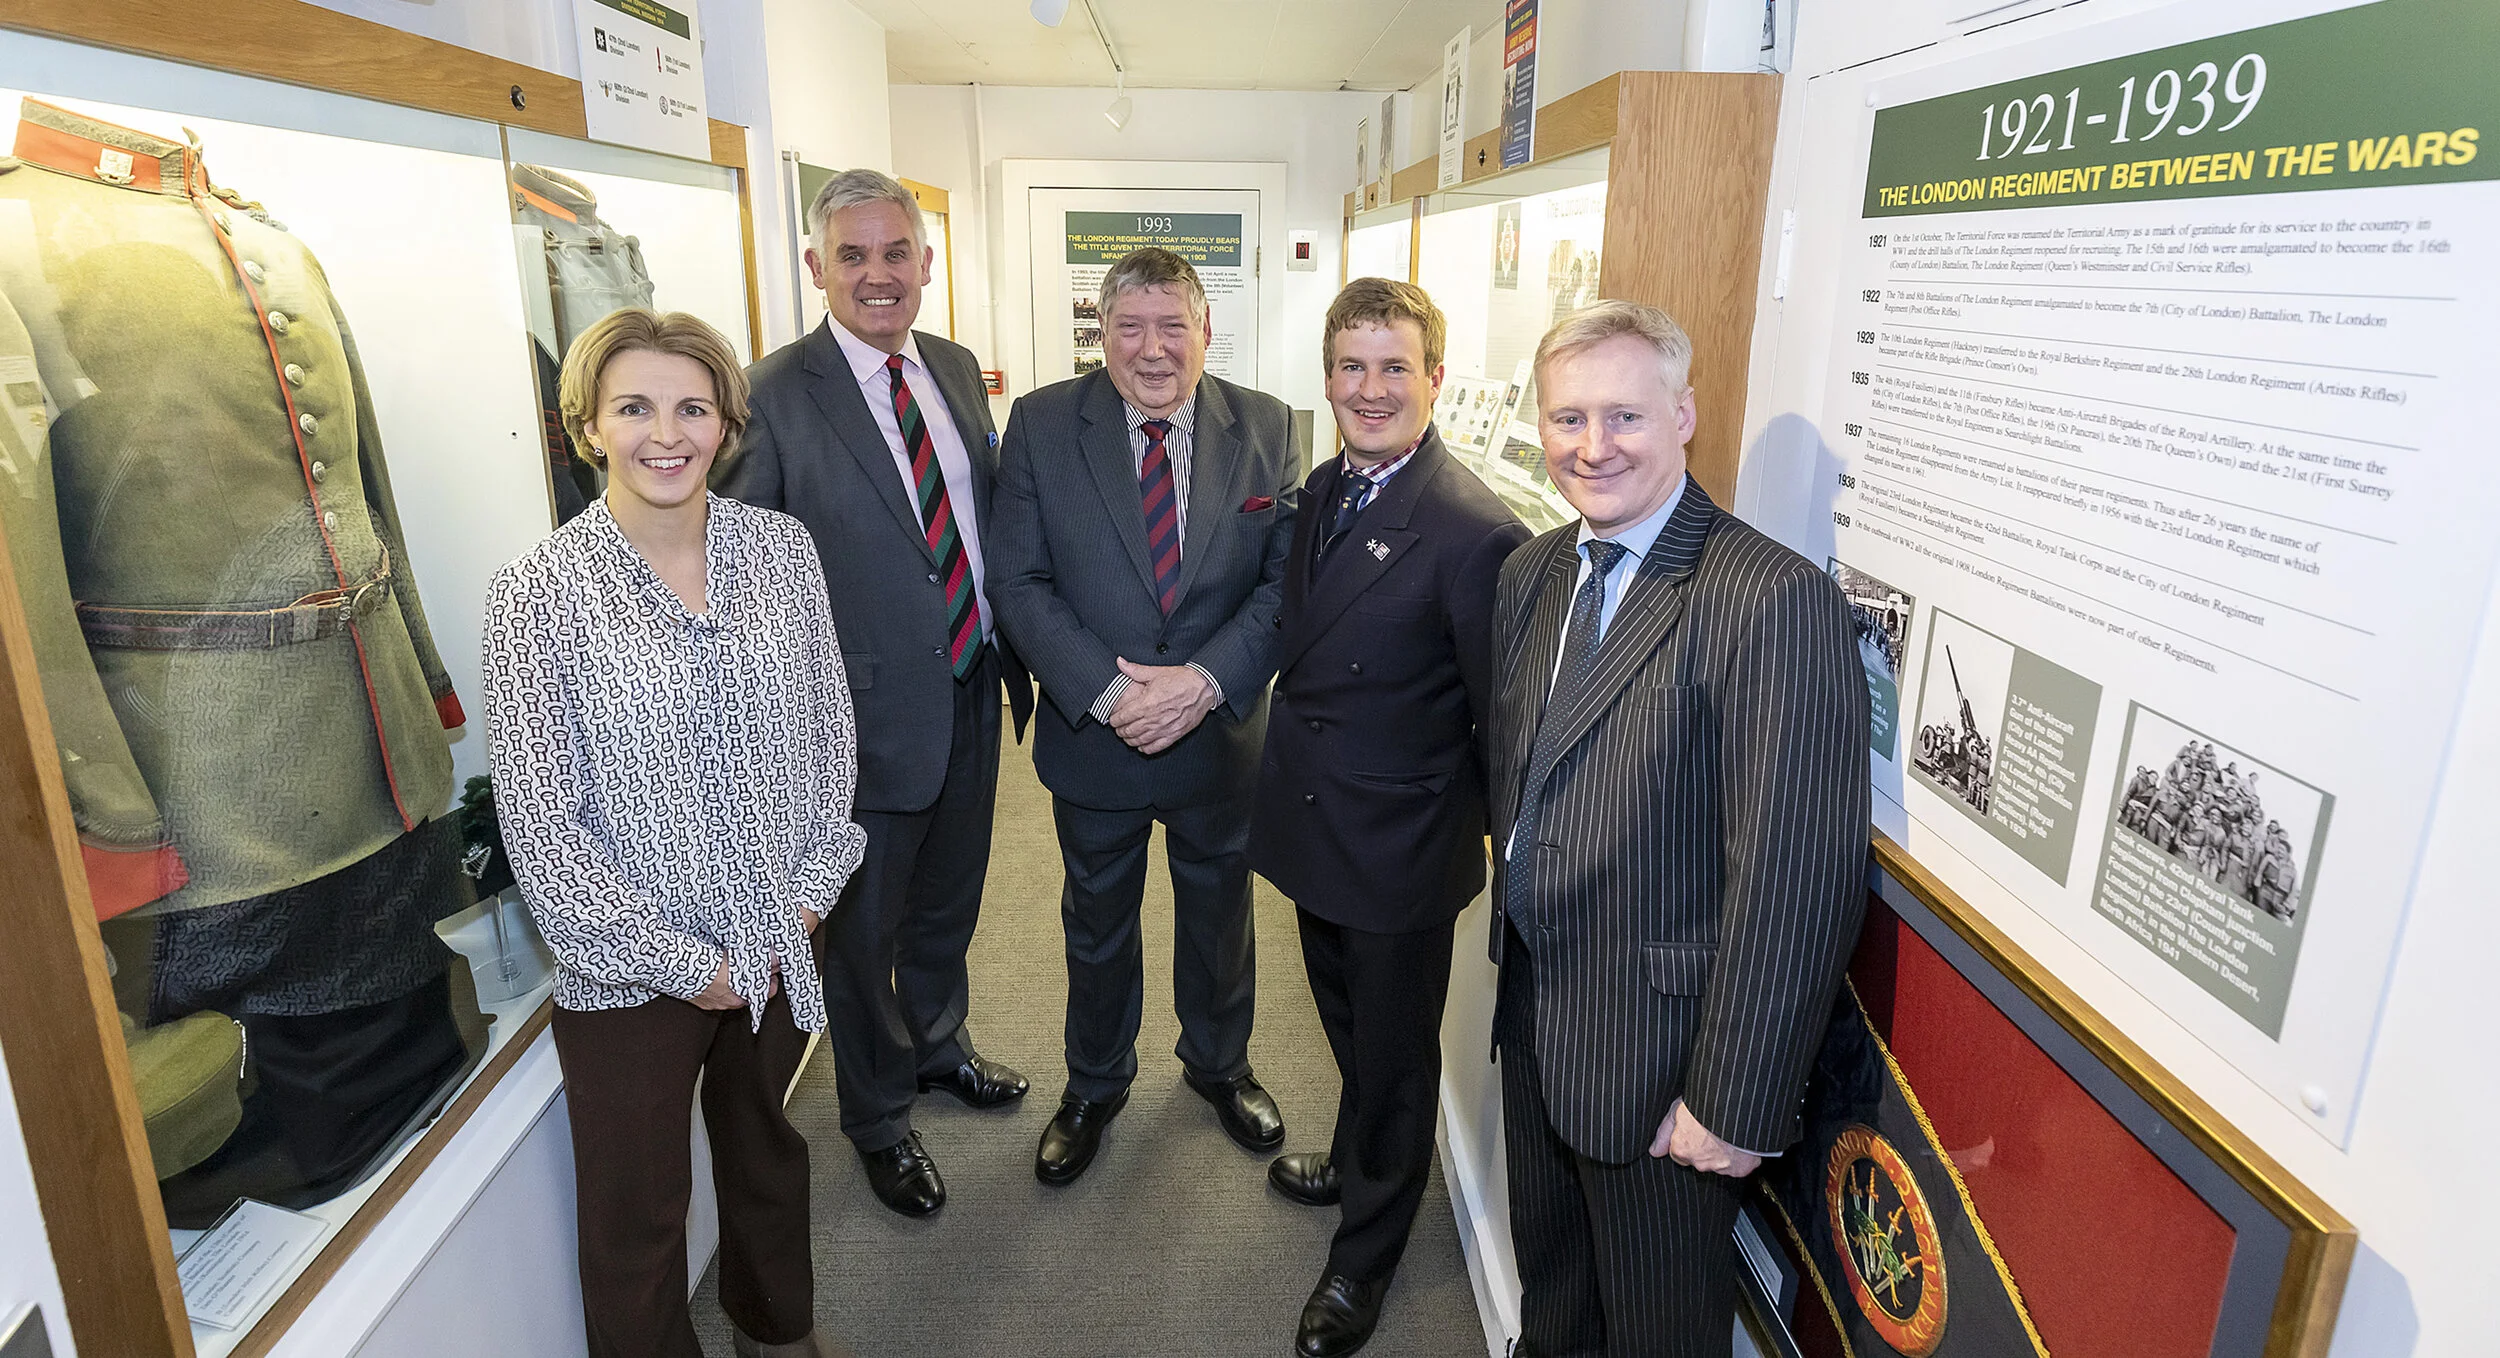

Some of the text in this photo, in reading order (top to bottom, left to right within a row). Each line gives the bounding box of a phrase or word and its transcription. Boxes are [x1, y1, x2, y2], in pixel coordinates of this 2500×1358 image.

[1975, 53, 2267, 161] 1921-1939
[1879, 127, 2479, 207] THE LONDON REGIMENT BETWEEN THE WARS
[1136, 216, 1173, 233] 1993
[1067, 234, 1082, 242] THE
[1083, 234, 1115, 243] LONDON
[1115, 235, 1153, 243] REGIMENT
[1180, 236, 1214, 244] PROUDLY
[1869, 234, 1887, 248] 1921
[1073, 243, 1088, 251] THE
[1089, 243, 1109, 251] TITLE
[1161, 245, 1209, 253] TERRITORIAL
[1862, 289, 1881, 303] 1922
[1857, 330, 1875, 345] 1929
[1851, 371, 1870, 386] 1935
[1845, 422, 1863, 438] 1937
[1838, 473, 1856, 490] 1938
[1833, 511, 1851, 528] 1939
[2110, 840, 2154, 877] Regiment
[2154, 869, 2178, 892] from
[2179, 885, 2226, 923] Clapham
[2114, 826, 2135, 848] Tank
[2168, 862, 2195, 885] 42nd
[2195, 877, 2227, 905] Royal
[2227, 896, 2254, 923] Tank
[2107, 854, 2246, 953] Formerly the 23rd (County of
[2099, 896, 2124, 922] North
[2157, 938, 2180, 961] 1941
[2104, 869, 2249, 974] London) Battalion The London
[2102, 882, 2260, 1002] Regiment, in the Western Desert,
